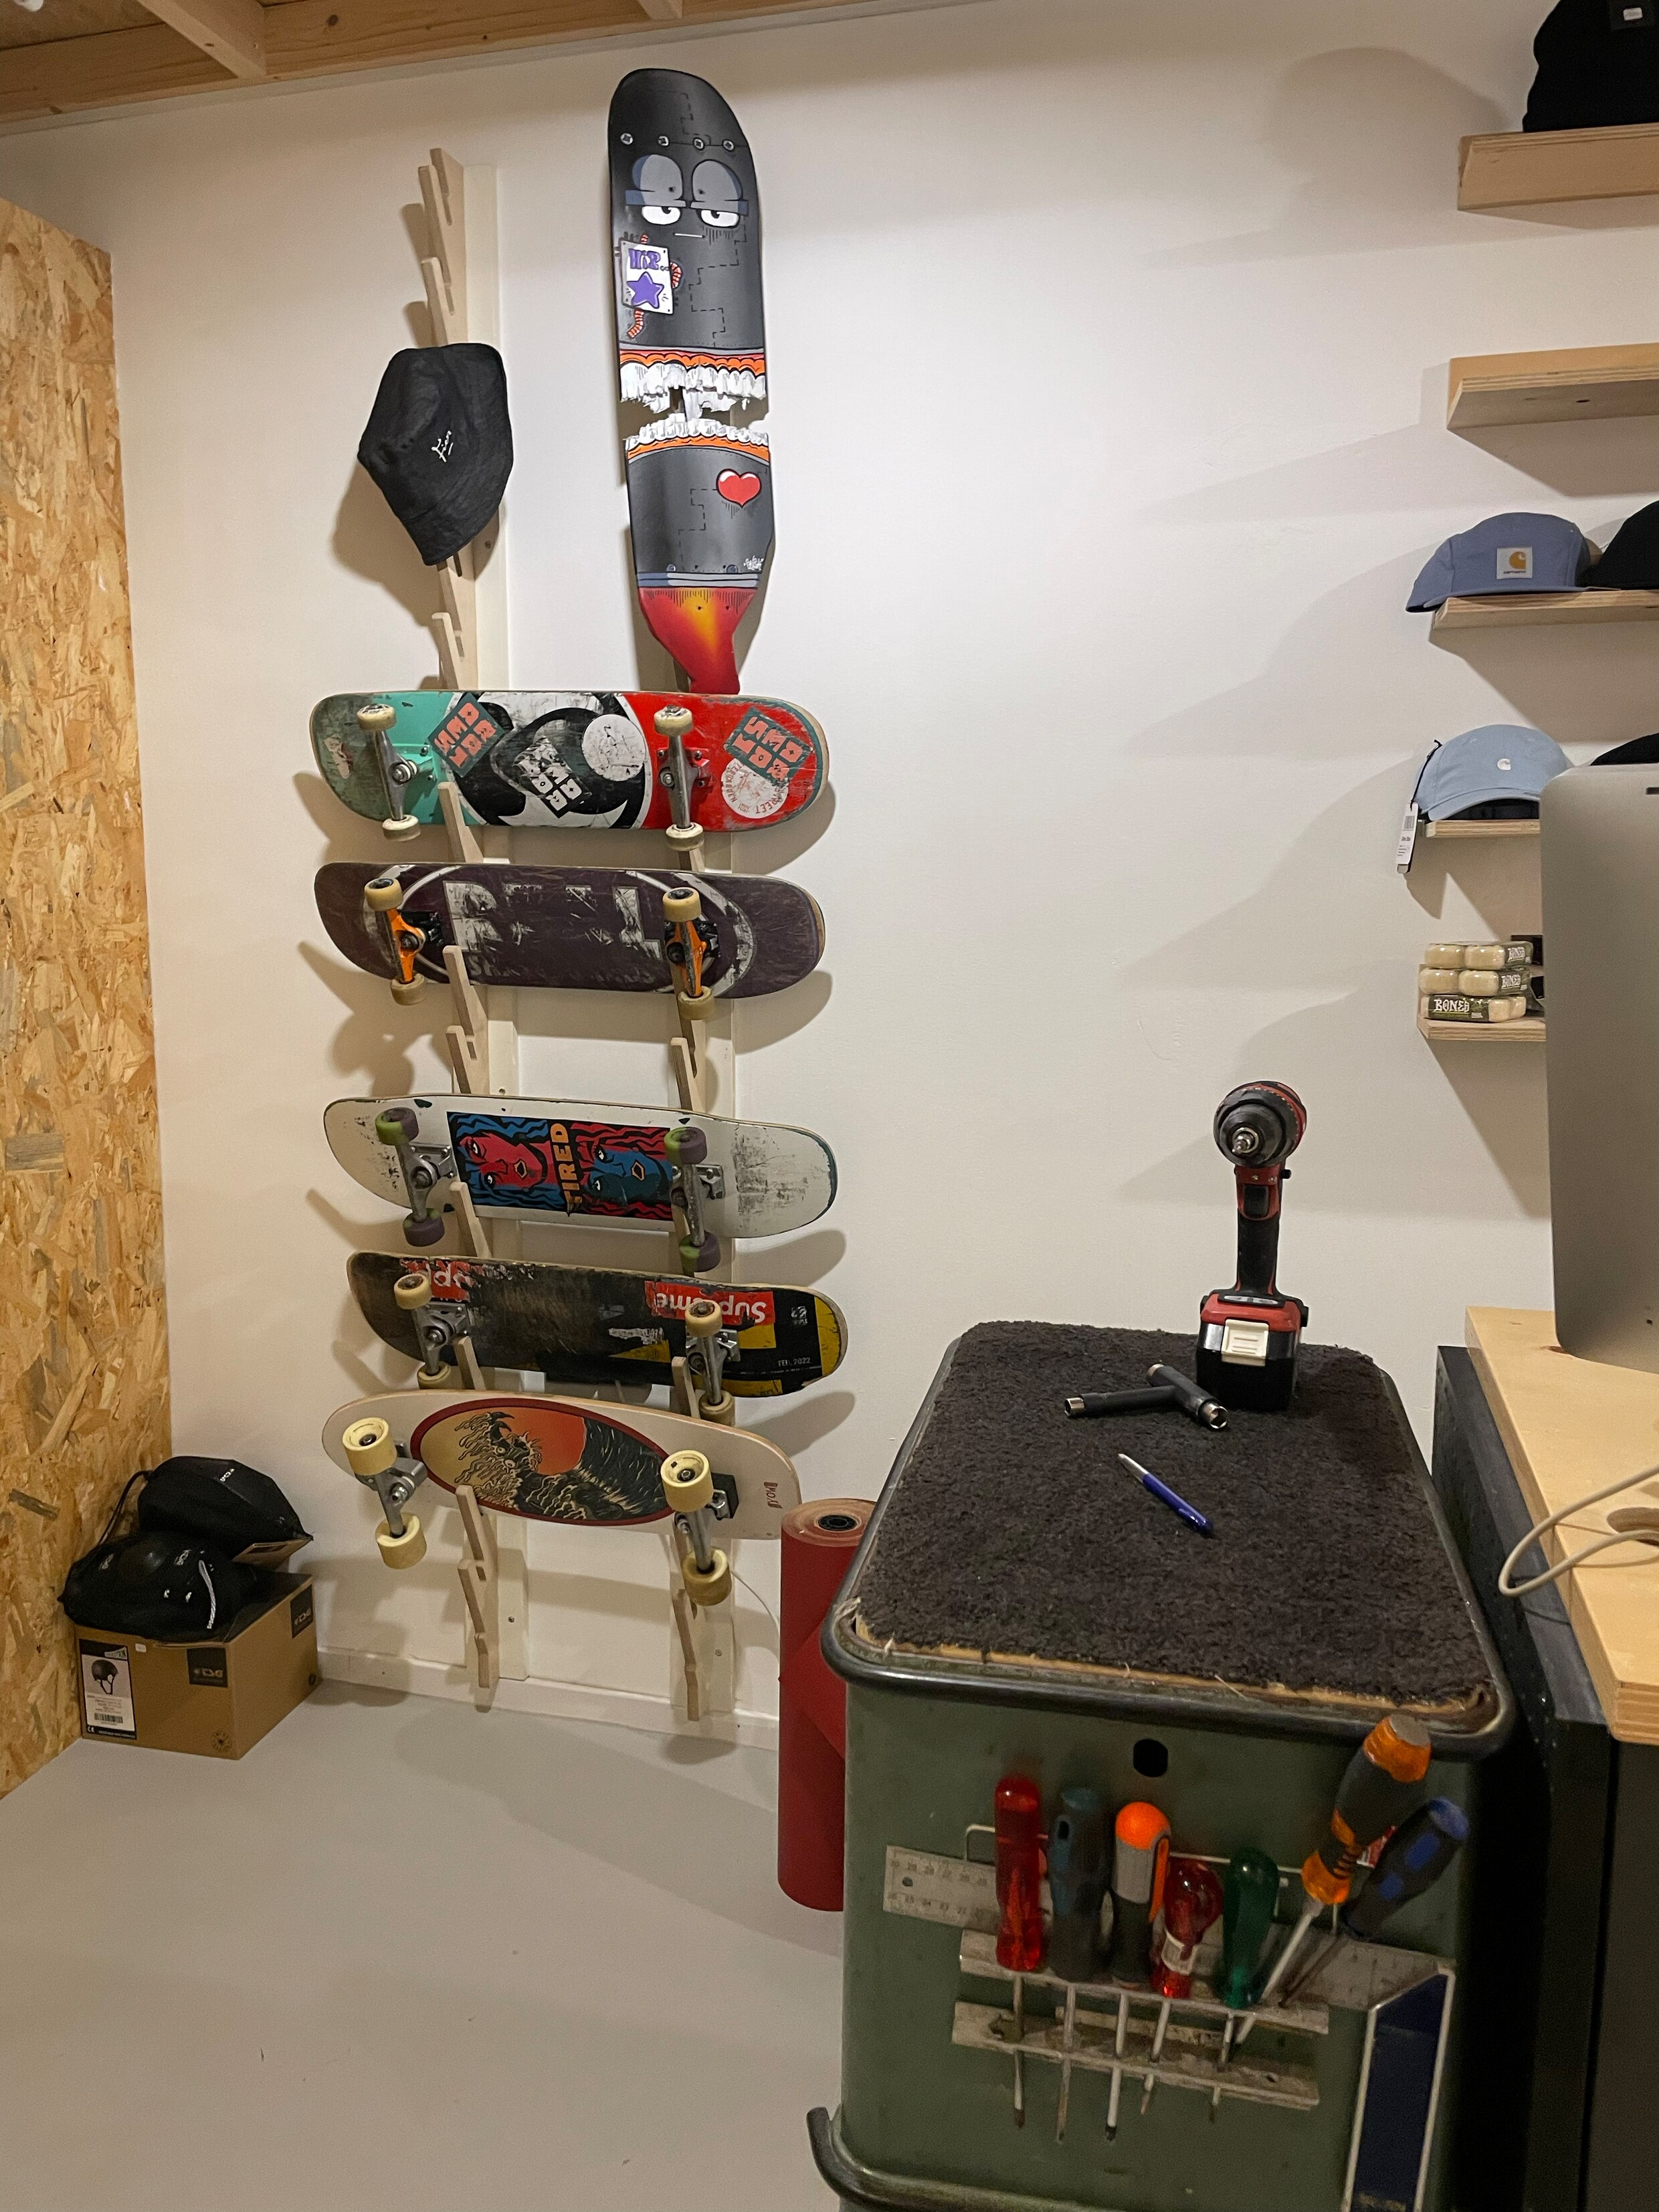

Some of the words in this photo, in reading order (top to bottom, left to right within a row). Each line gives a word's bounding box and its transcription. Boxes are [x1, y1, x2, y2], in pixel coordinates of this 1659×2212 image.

[1434, 999, 1470, 1013] BONES
[550, 1122, 582, 1205] TIRED
[654, 1291, 767, 1324] Supme
[793, 1357, 811, 1365] 2022
